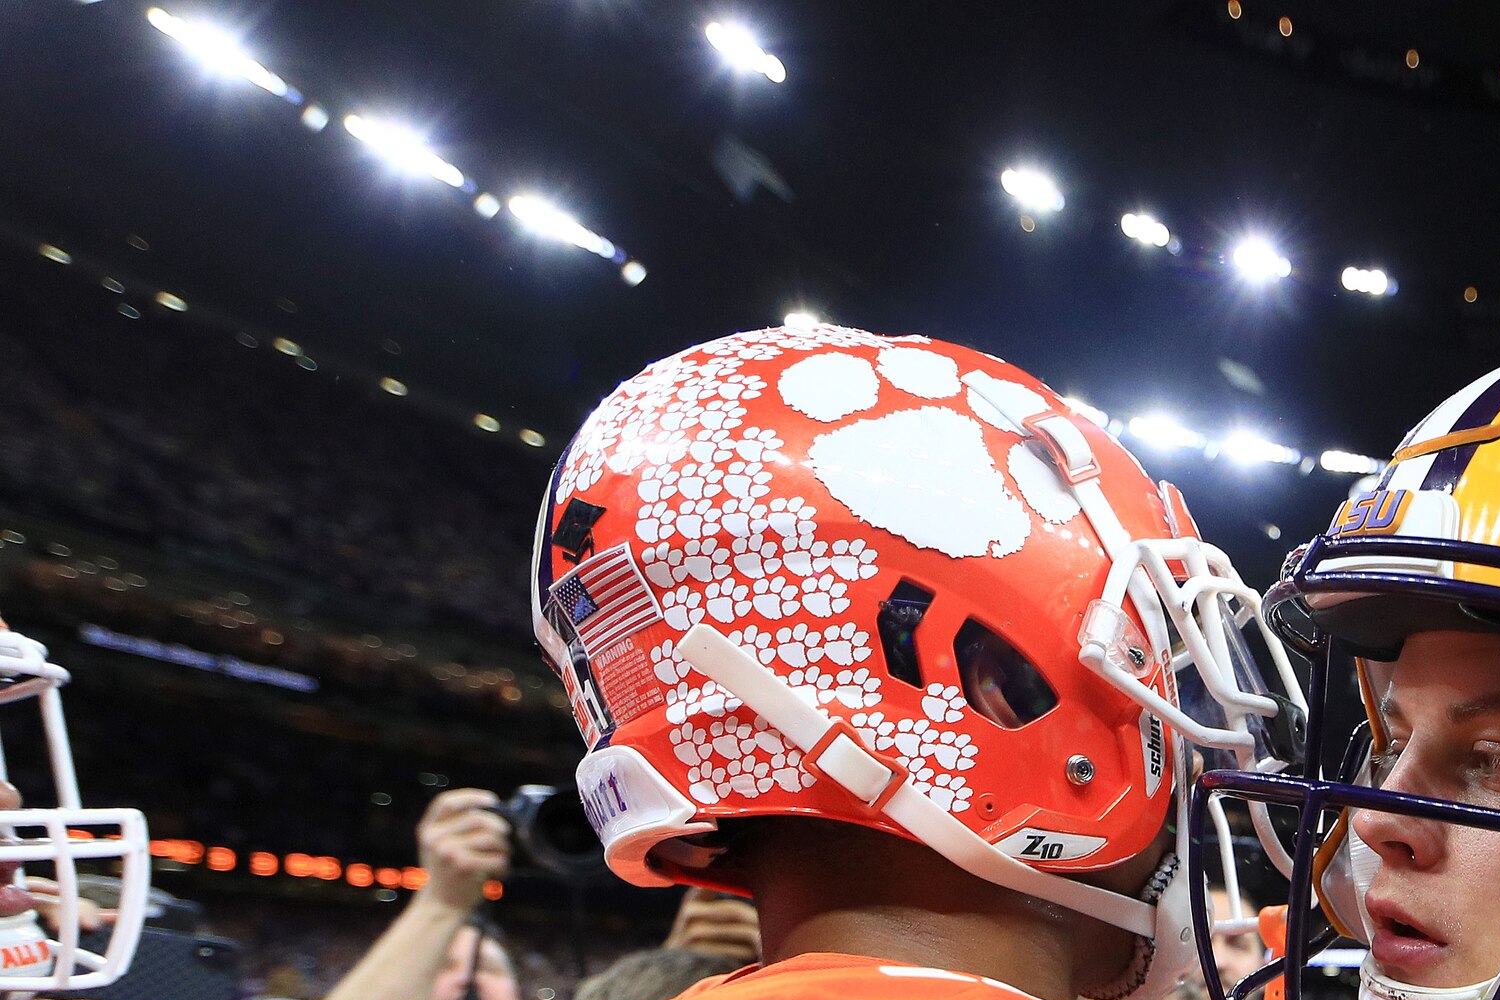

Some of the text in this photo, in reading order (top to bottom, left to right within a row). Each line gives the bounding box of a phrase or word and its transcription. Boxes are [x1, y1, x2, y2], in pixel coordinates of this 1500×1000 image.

[1328, 489, 1412, 537] LSU
[595, 637, 635, 669] WARNING
[1147, 711, 1161, 778] schut
